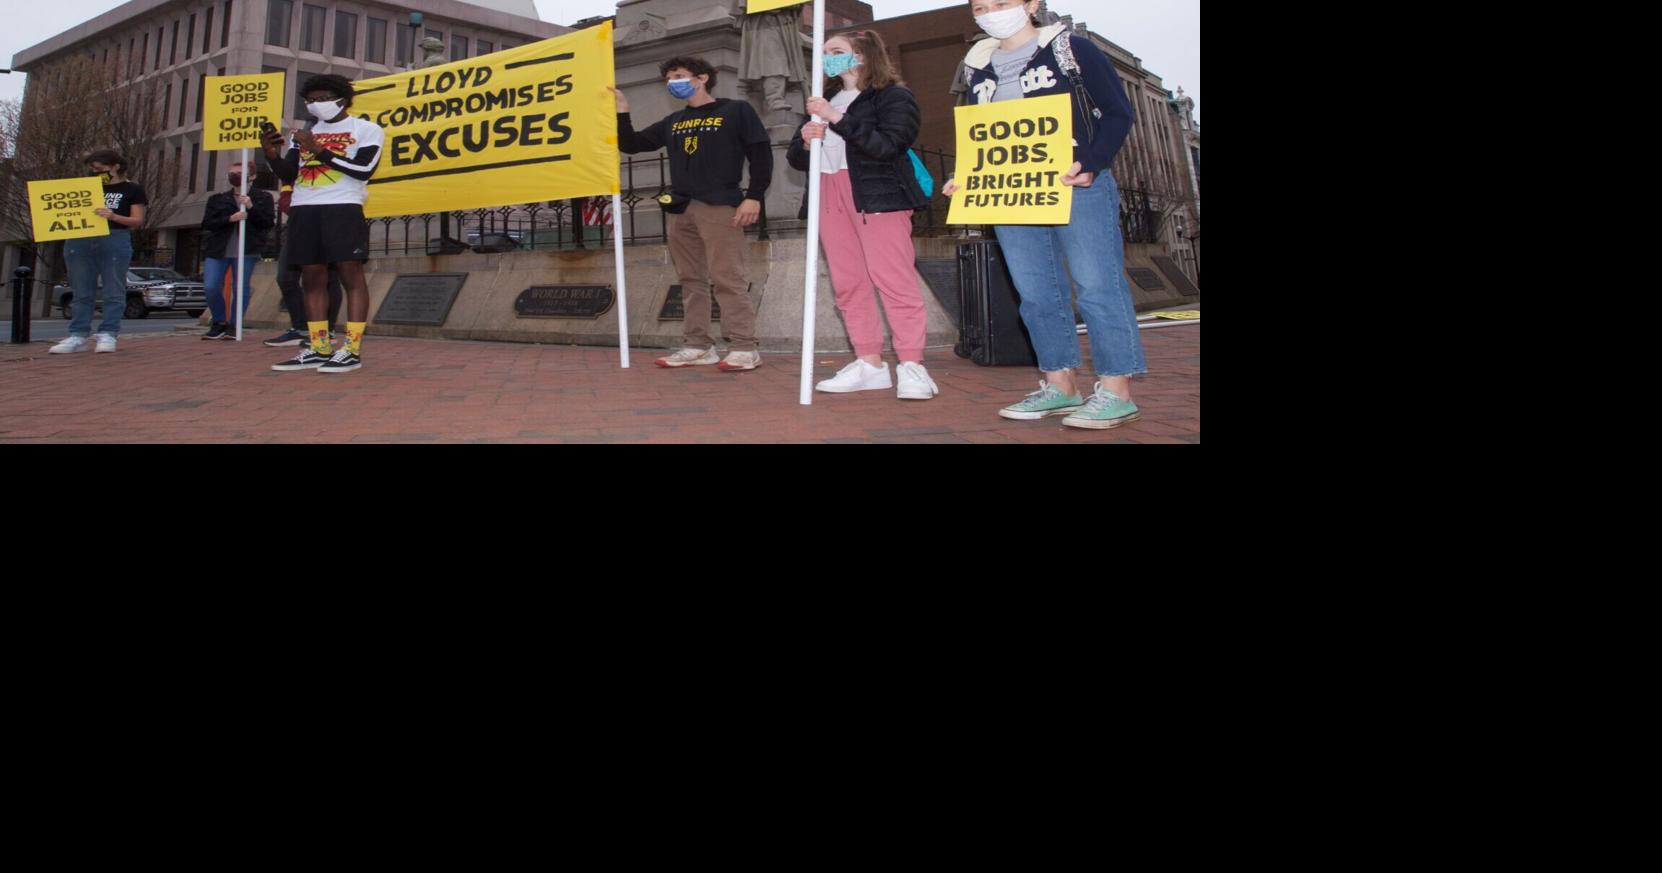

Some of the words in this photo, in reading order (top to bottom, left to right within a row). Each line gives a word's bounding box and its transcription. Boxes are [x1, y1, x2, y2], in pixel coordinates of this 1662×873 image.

[220, 82, 269, 93] GOOD
[406, 66, 492, 98] LLOYD
[221, 92, 268, 105] JOBS
[376, 74, 573, 129] COMPROMISES
[231, 106, 258, 114] FOR
[219, 116, 268, 131] OUR
[672, 117, 723, 131] SUNRISE
[969, 116, 1059, 142] GOOD
[391, 112, 572, 166] EXCUSES
[972, 143, 1054, 172] JOBS,
[966, 171, 1059, 190] BRIGHT
[41, 190, 92, 202] GOOD
[964, 192, 1059, 208] FUTURES
[43, 199, 93, 211] JOBS
[49, 218, 95, 232] ALL
[531, 288, 568, 299] WORLD
[570, 288, 594, 298] WAR
